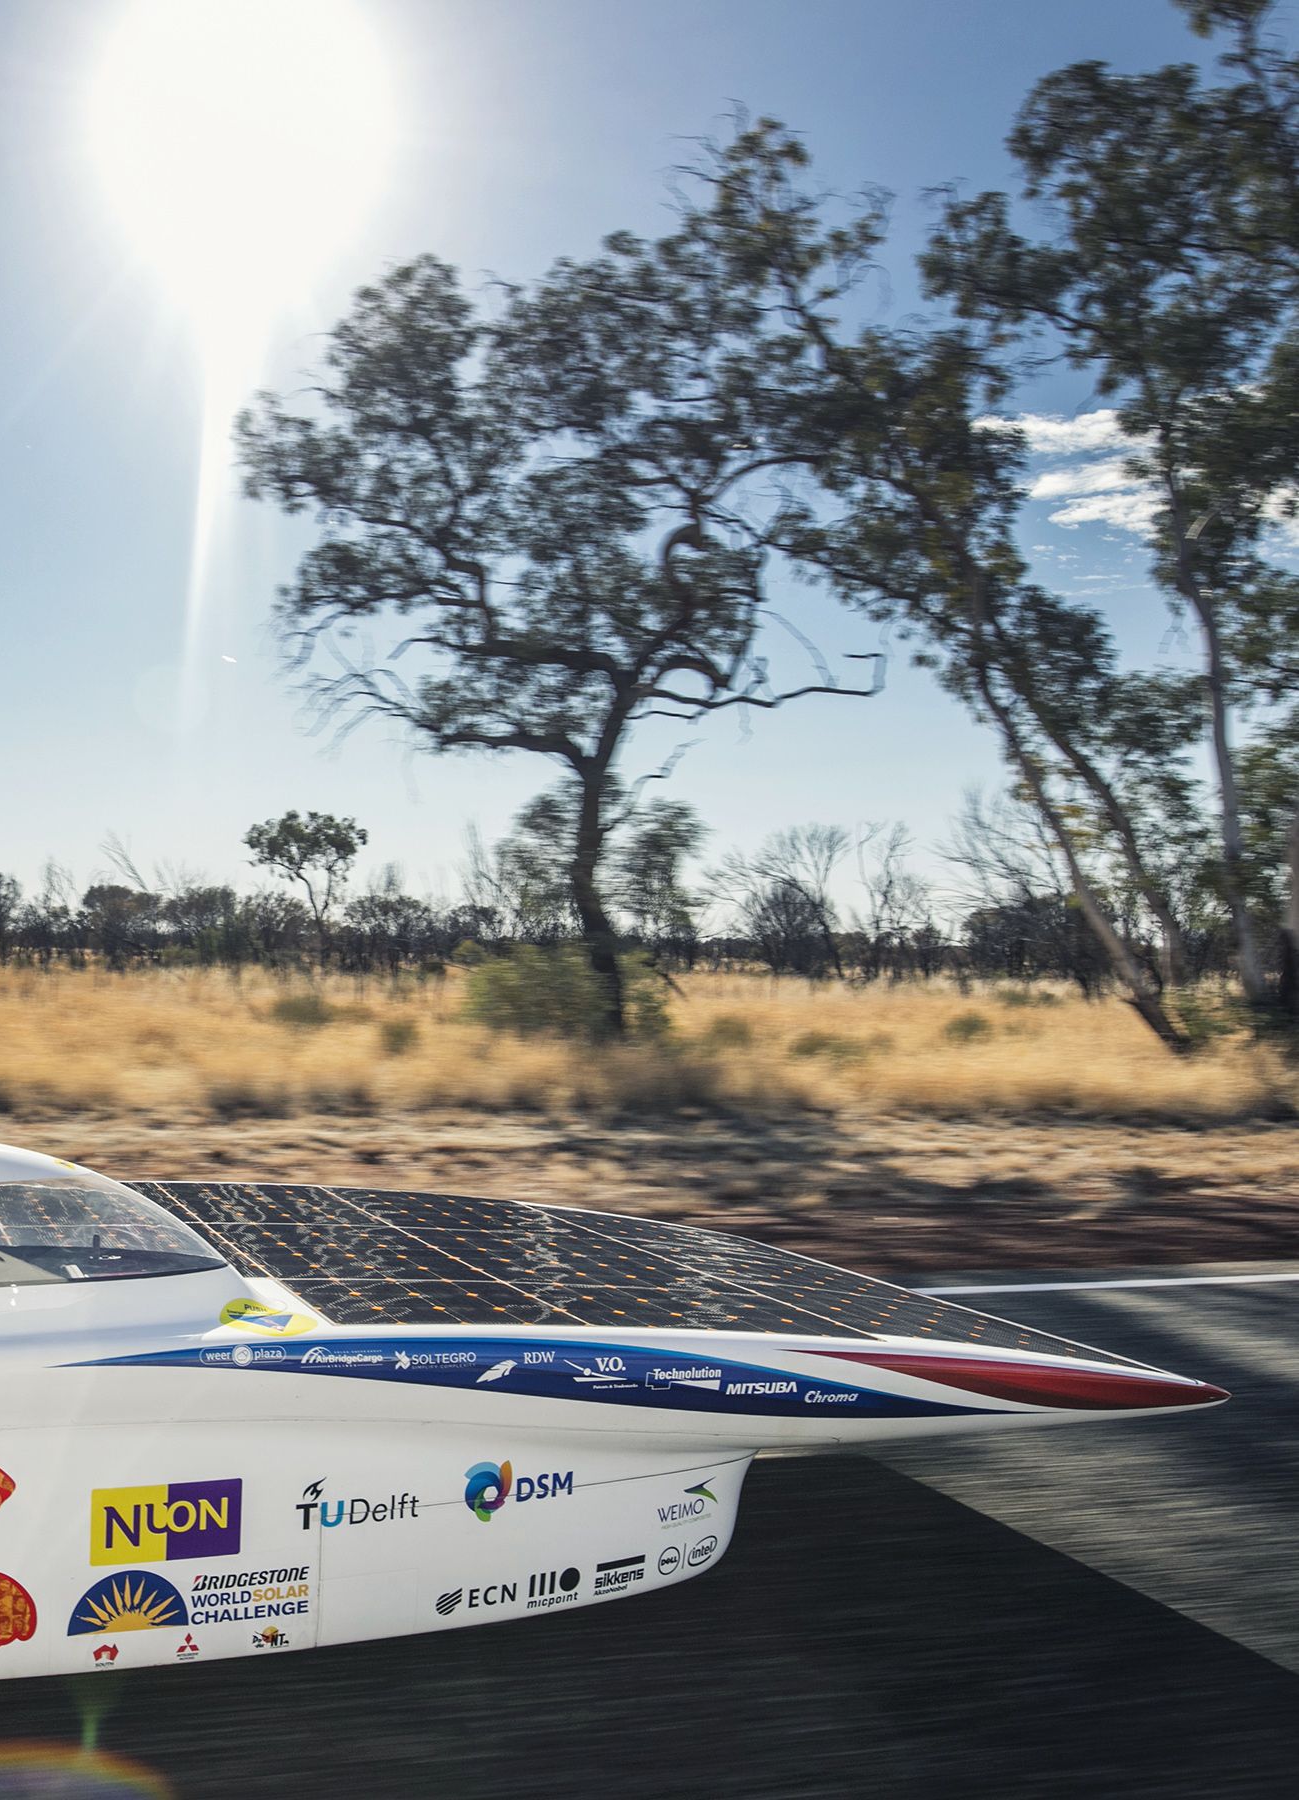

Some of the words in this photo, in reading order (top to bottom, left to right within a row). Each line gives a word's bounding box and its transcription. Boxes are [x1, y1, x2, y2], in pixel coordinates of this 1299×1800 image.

[205, 1351, 231, 1361] weer
[254, 1349, 283, 1361] plaza
[315, 1353, 384, 1365] AirBridgeCargo
[412, 1351, 477, 1365] SOLTEGRO
[523, 1351, 556, 1365] RDW
[595, 1356, 627, 1372] V.O.
[653, 1366, 722, 1380] Technolution
[726, 1381, 798, 1395] MITSUBA
[804, 1391, 859, 1404] Chroma
[516, 1471, 573, 1502] DSM
[657, 1498, 705, 1522] WEIMO
[103, 1497, 229, 1549] NUON
[692, 1541, 715, 1560] intel
[661, 1556, 677, 1566] DELL
[191, 1566, 310, 1592] BRIDGESTONE
[594, 1568, 645, 1589] sikkens
[468, 1582, 518, 1608] ECN
[527, 1592, 579, 1609] micpoint
[191, 1600, 309, 1625] CHALLENGE
